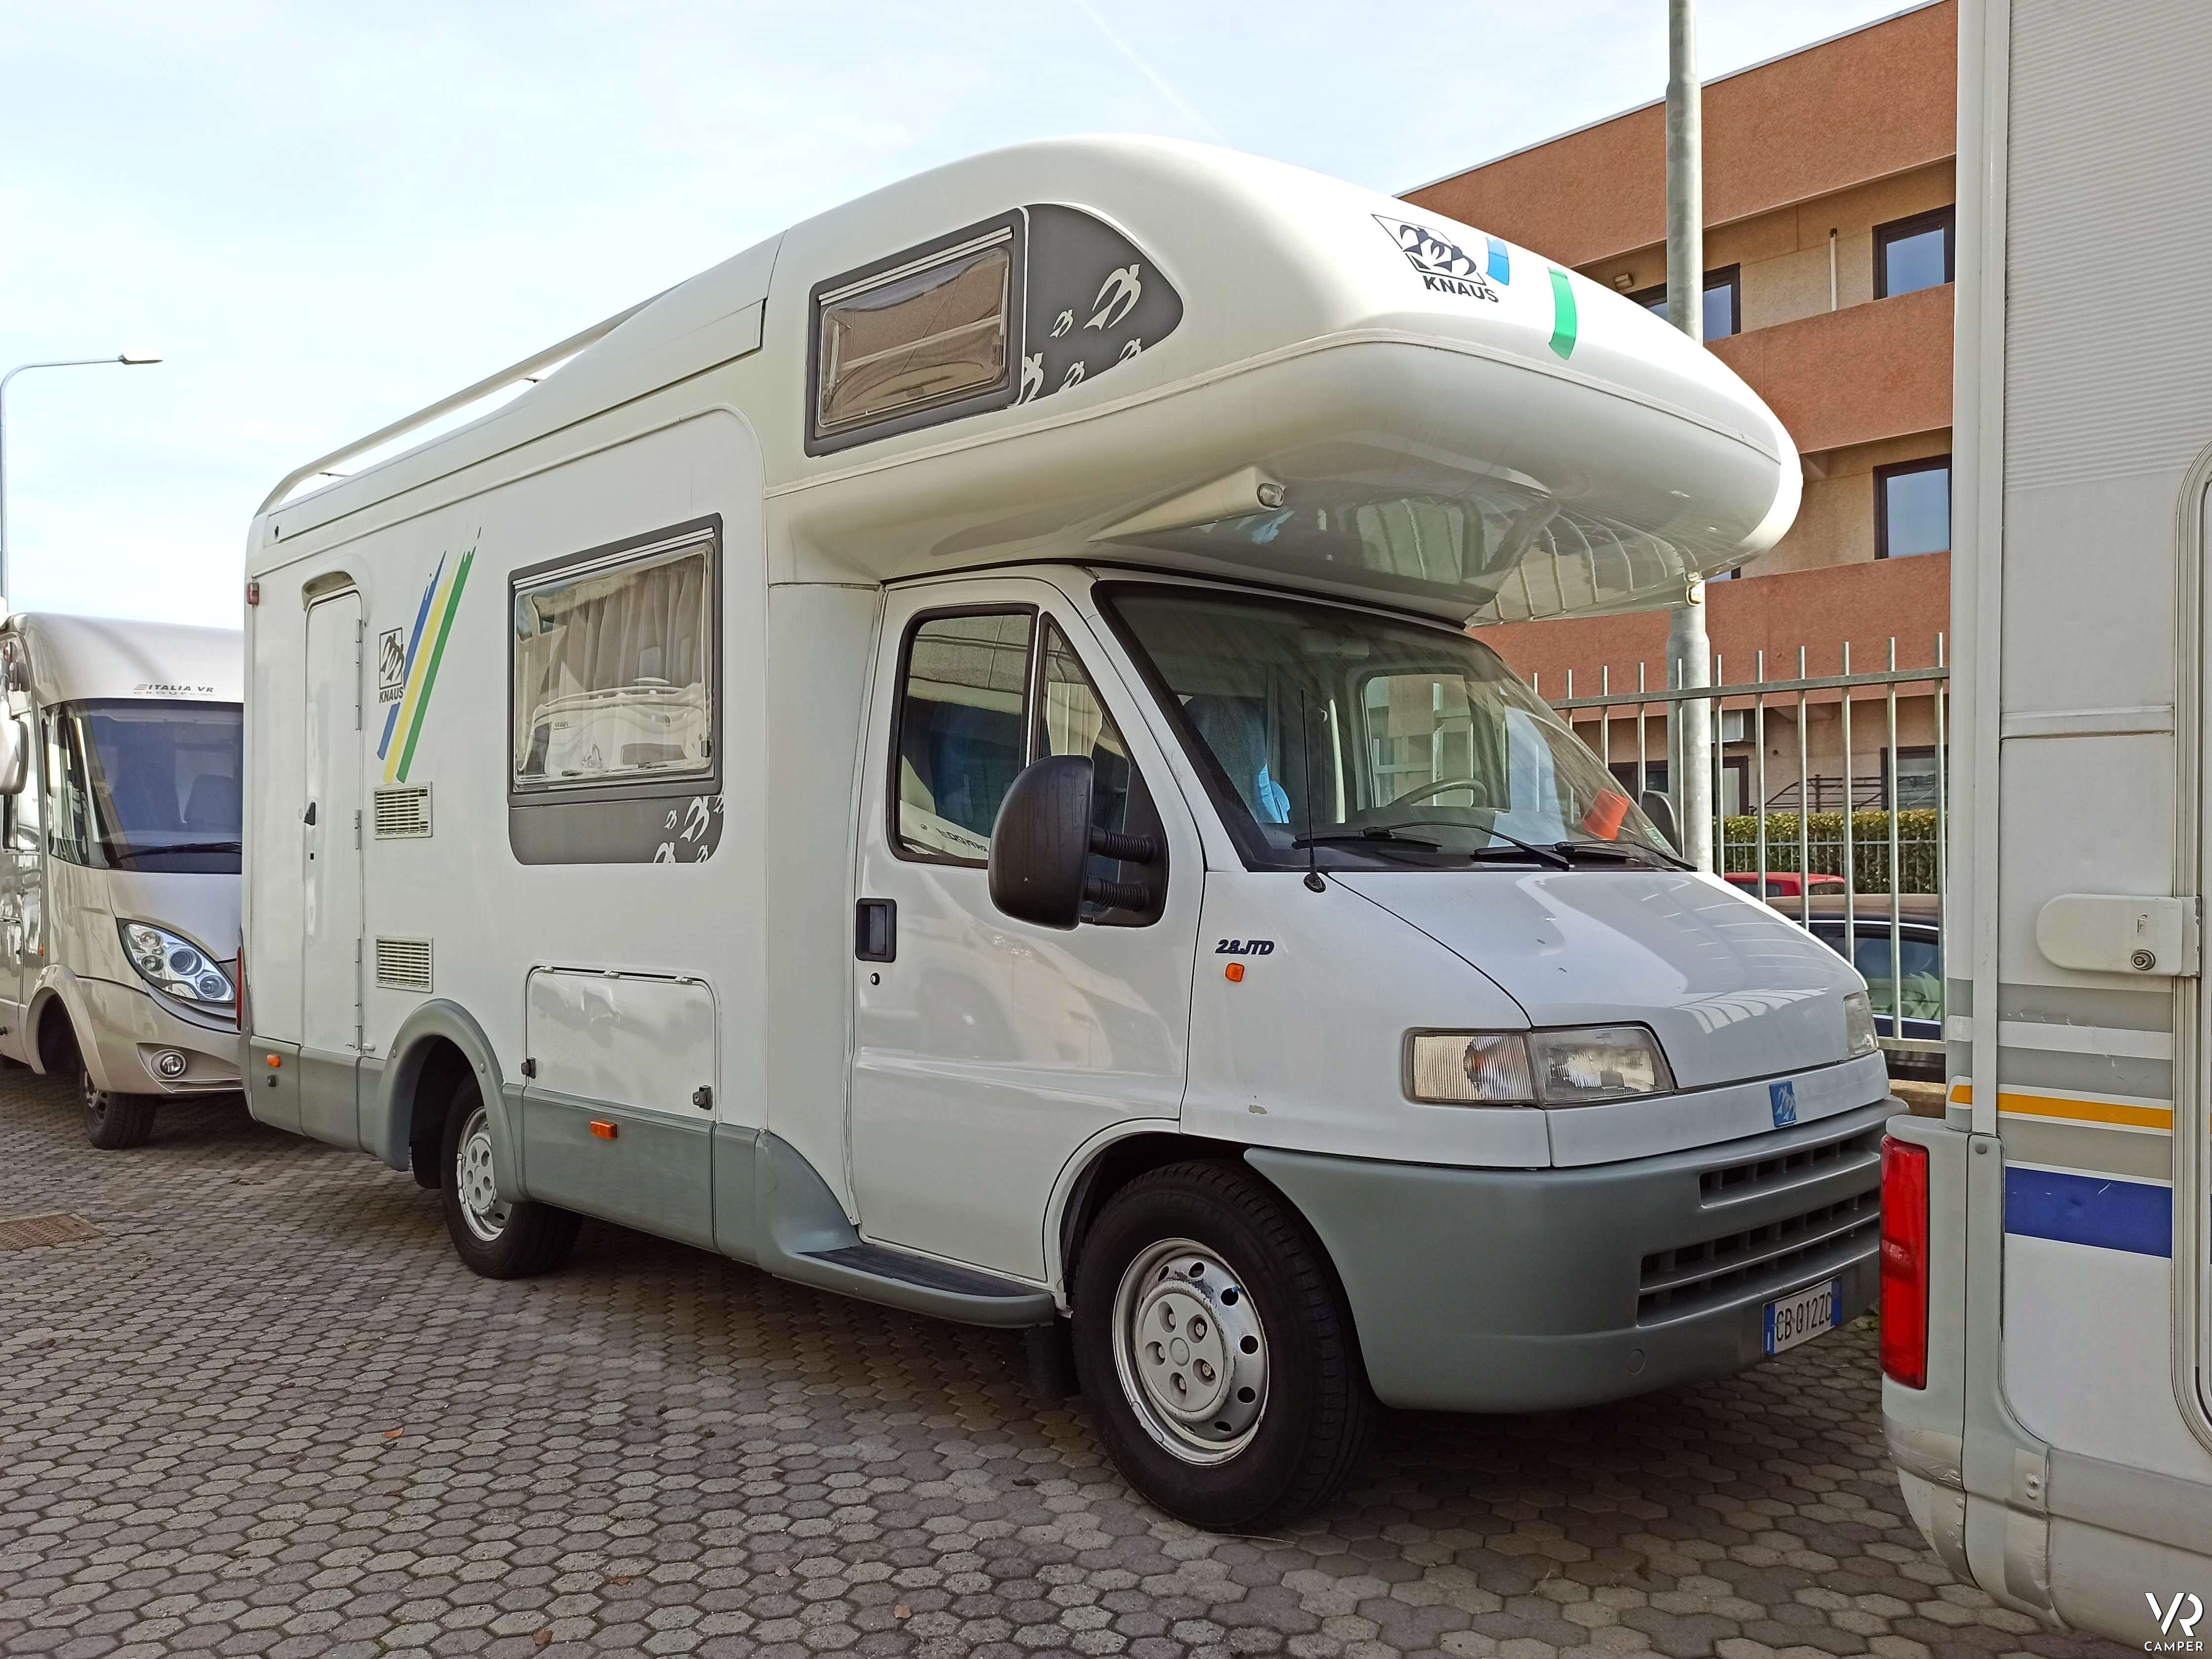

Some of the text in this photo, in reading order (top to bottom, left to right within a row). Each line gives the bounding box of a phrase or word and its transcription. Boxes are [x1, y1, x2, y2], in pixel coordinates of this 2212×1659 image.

[1423, 275, 1499, 303] KNAUS
[379, 686, 403, 703] KNAUS
[1776, 1307, 1792, 1342] CB
